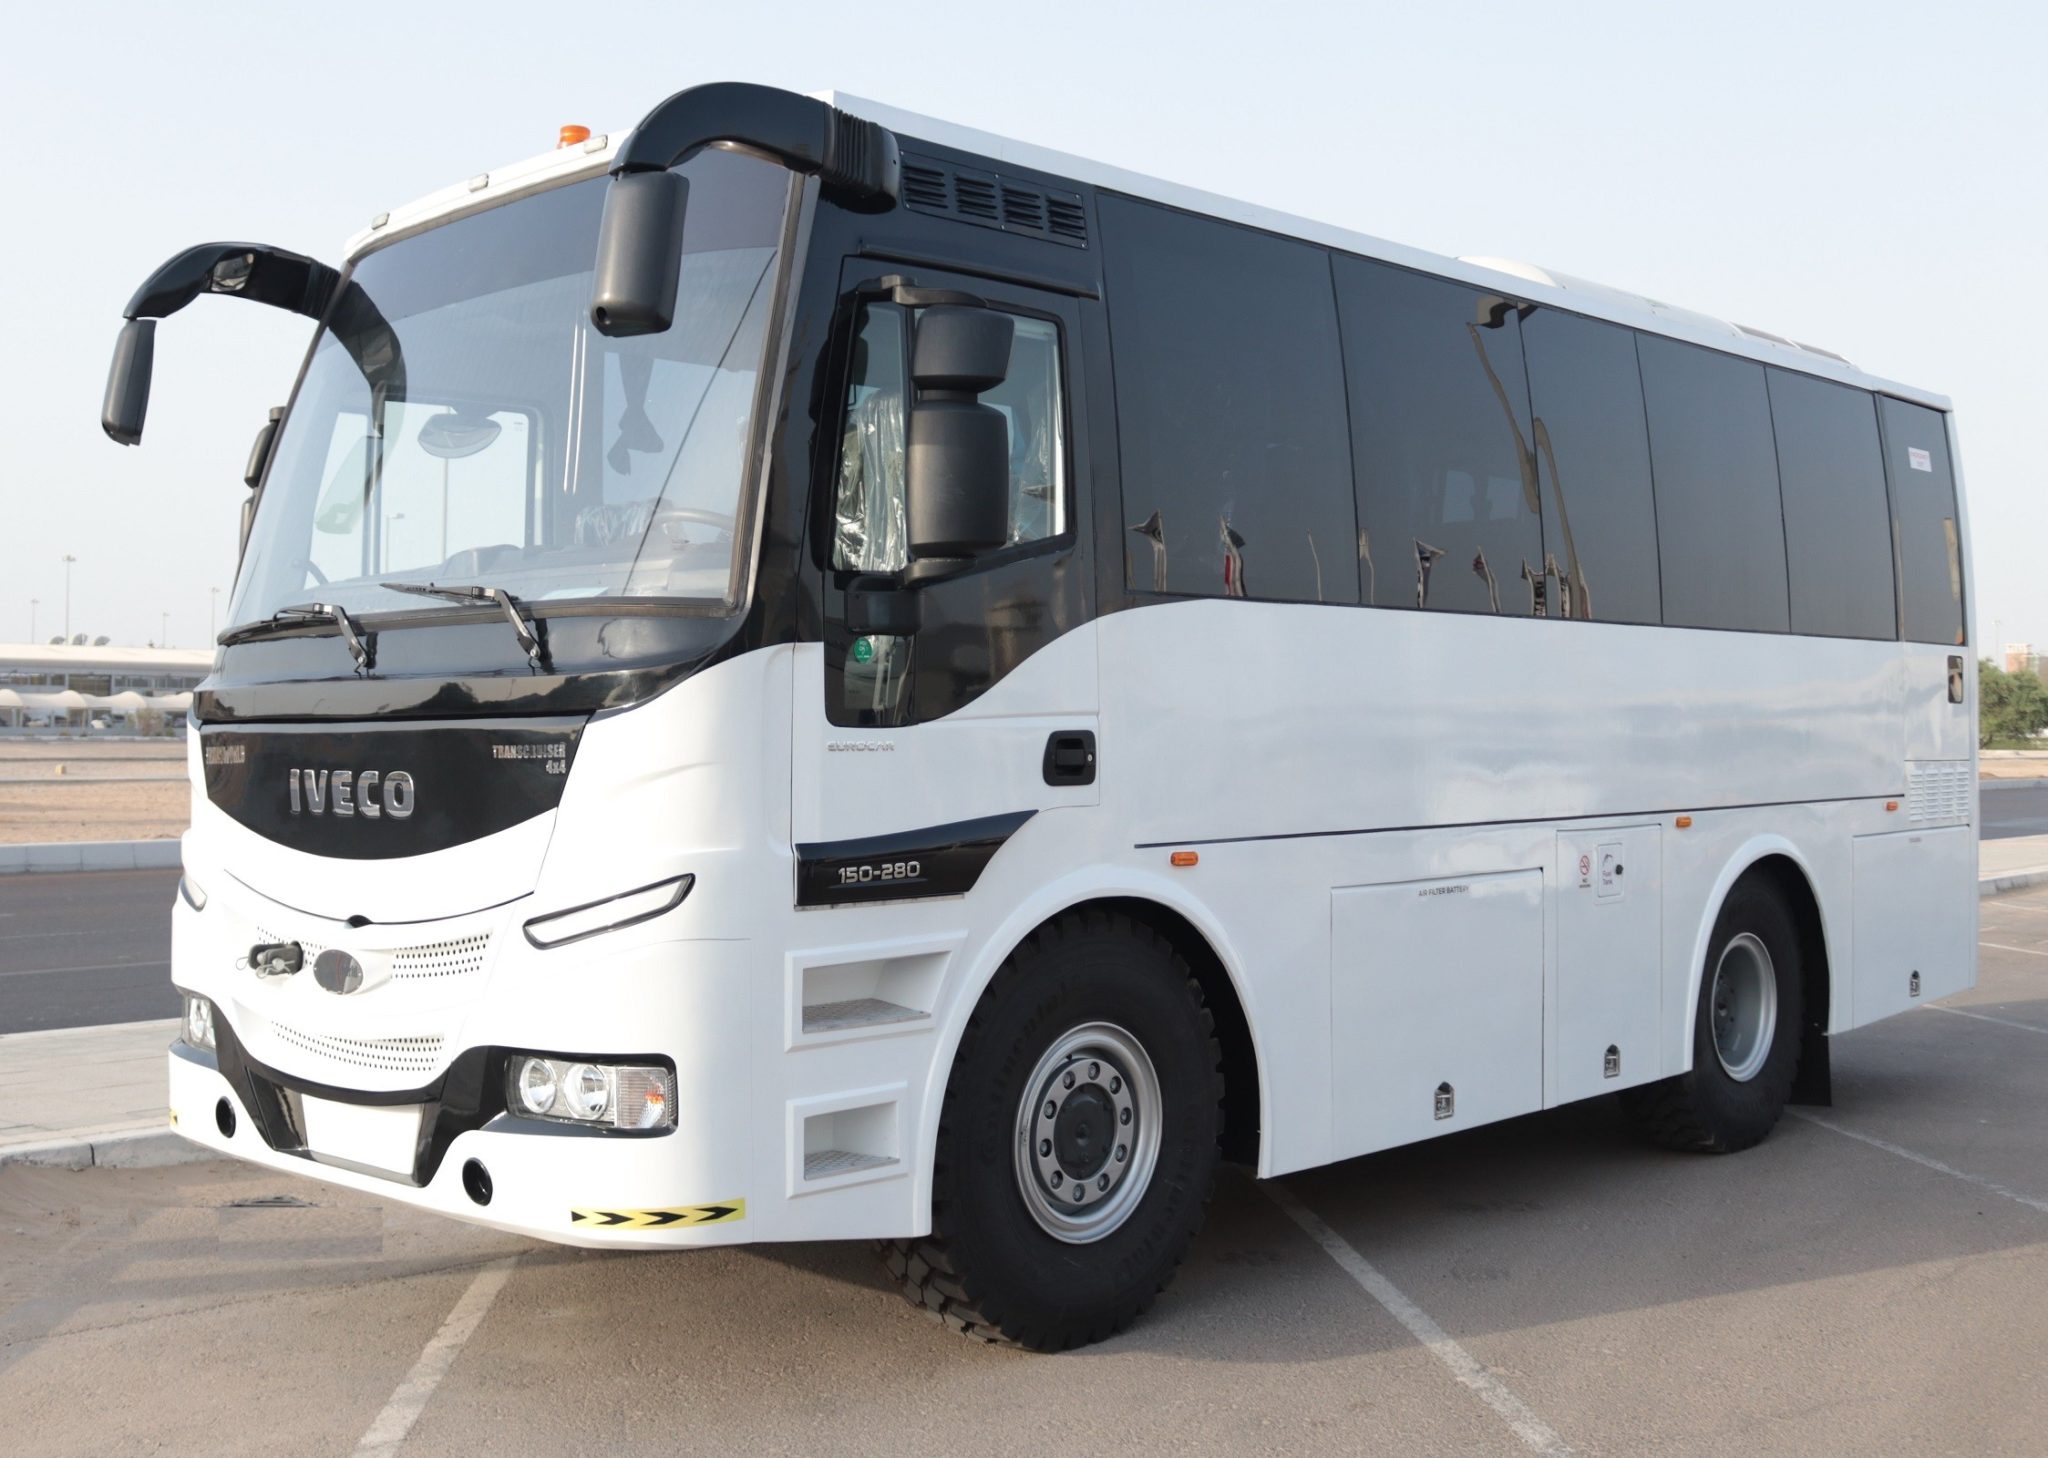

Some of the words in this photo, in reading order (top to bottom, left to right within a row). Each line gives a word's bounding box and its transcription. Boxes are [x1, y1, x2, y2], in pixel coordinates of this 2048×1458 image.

[827, 740, 895, 752] EUROCAR
[545, 759, 567, 774] 4x4
[289, 768, 415, 818] IVECO
[838, 861, 920, 884] 150-280
